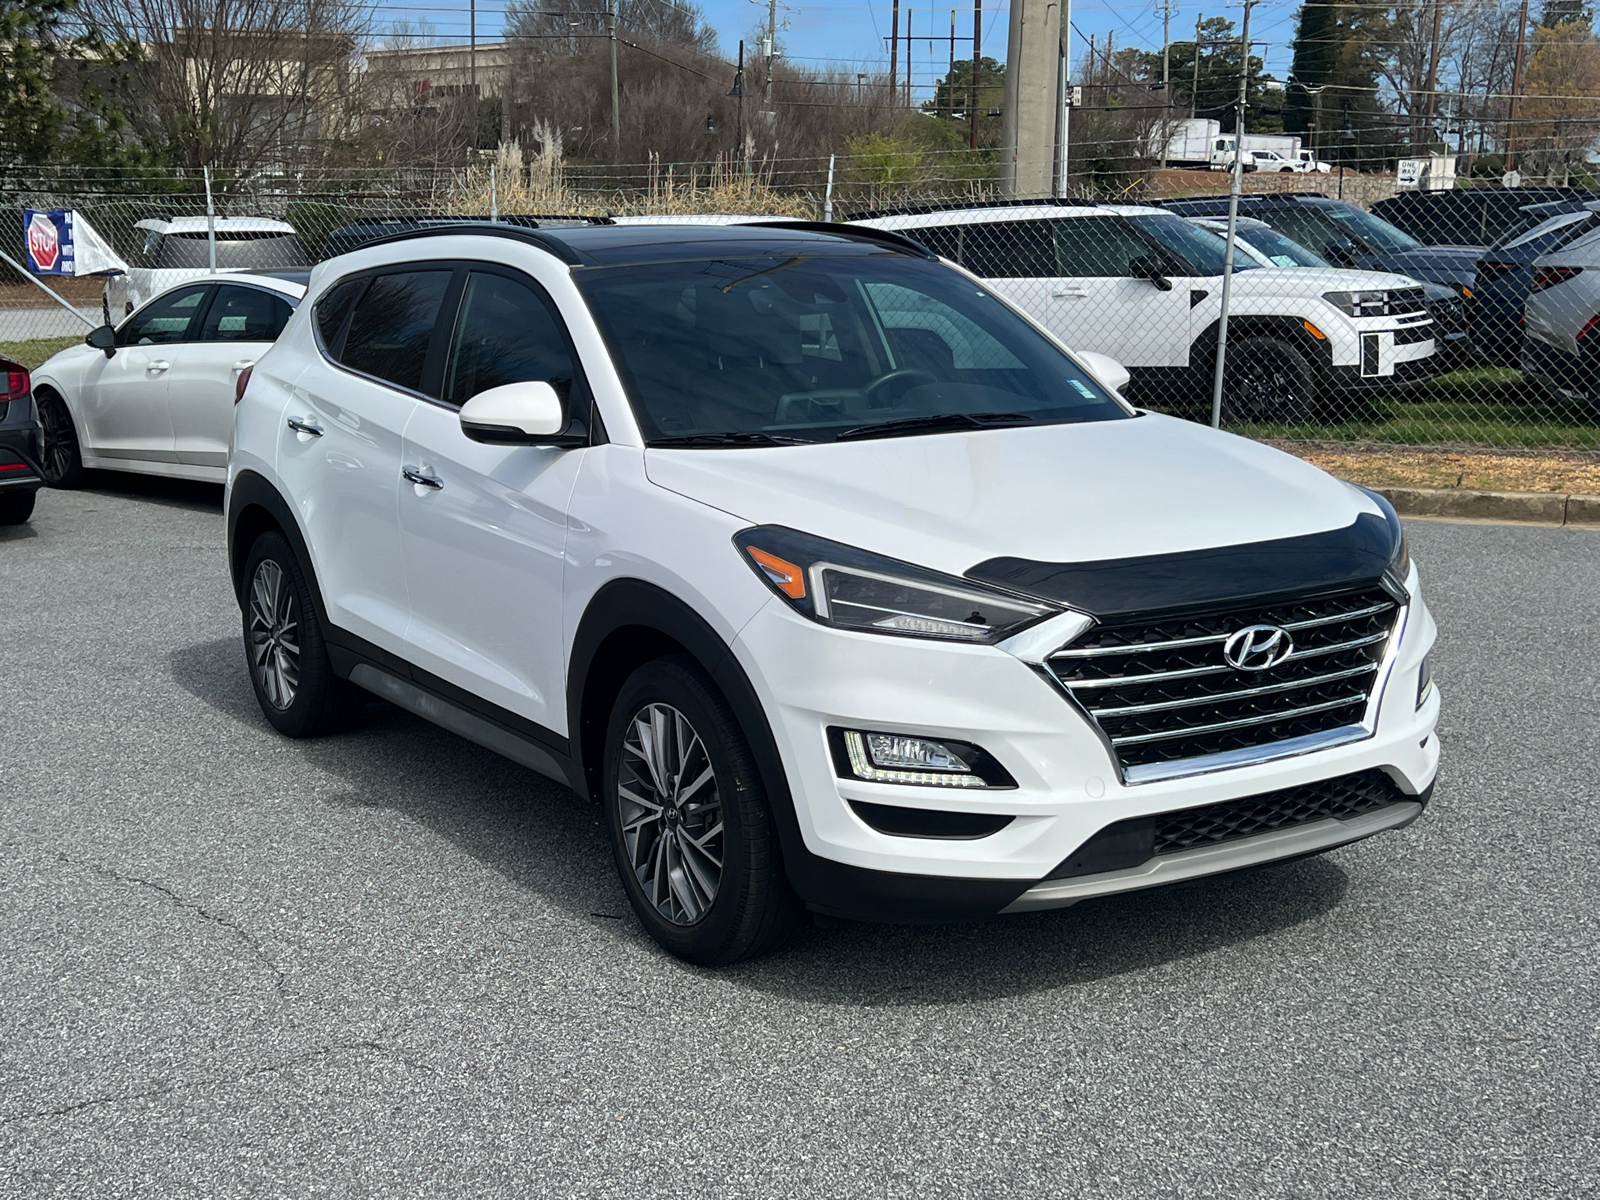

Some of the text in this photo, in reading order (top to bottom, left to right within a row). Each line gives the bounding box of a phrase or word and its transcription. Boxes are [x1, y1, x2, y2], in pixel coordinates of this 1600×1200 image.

[64, 212, 73, 225] AL
[32, 232, 55, 251] STOP
[61, 260, 75, 272] DRO
